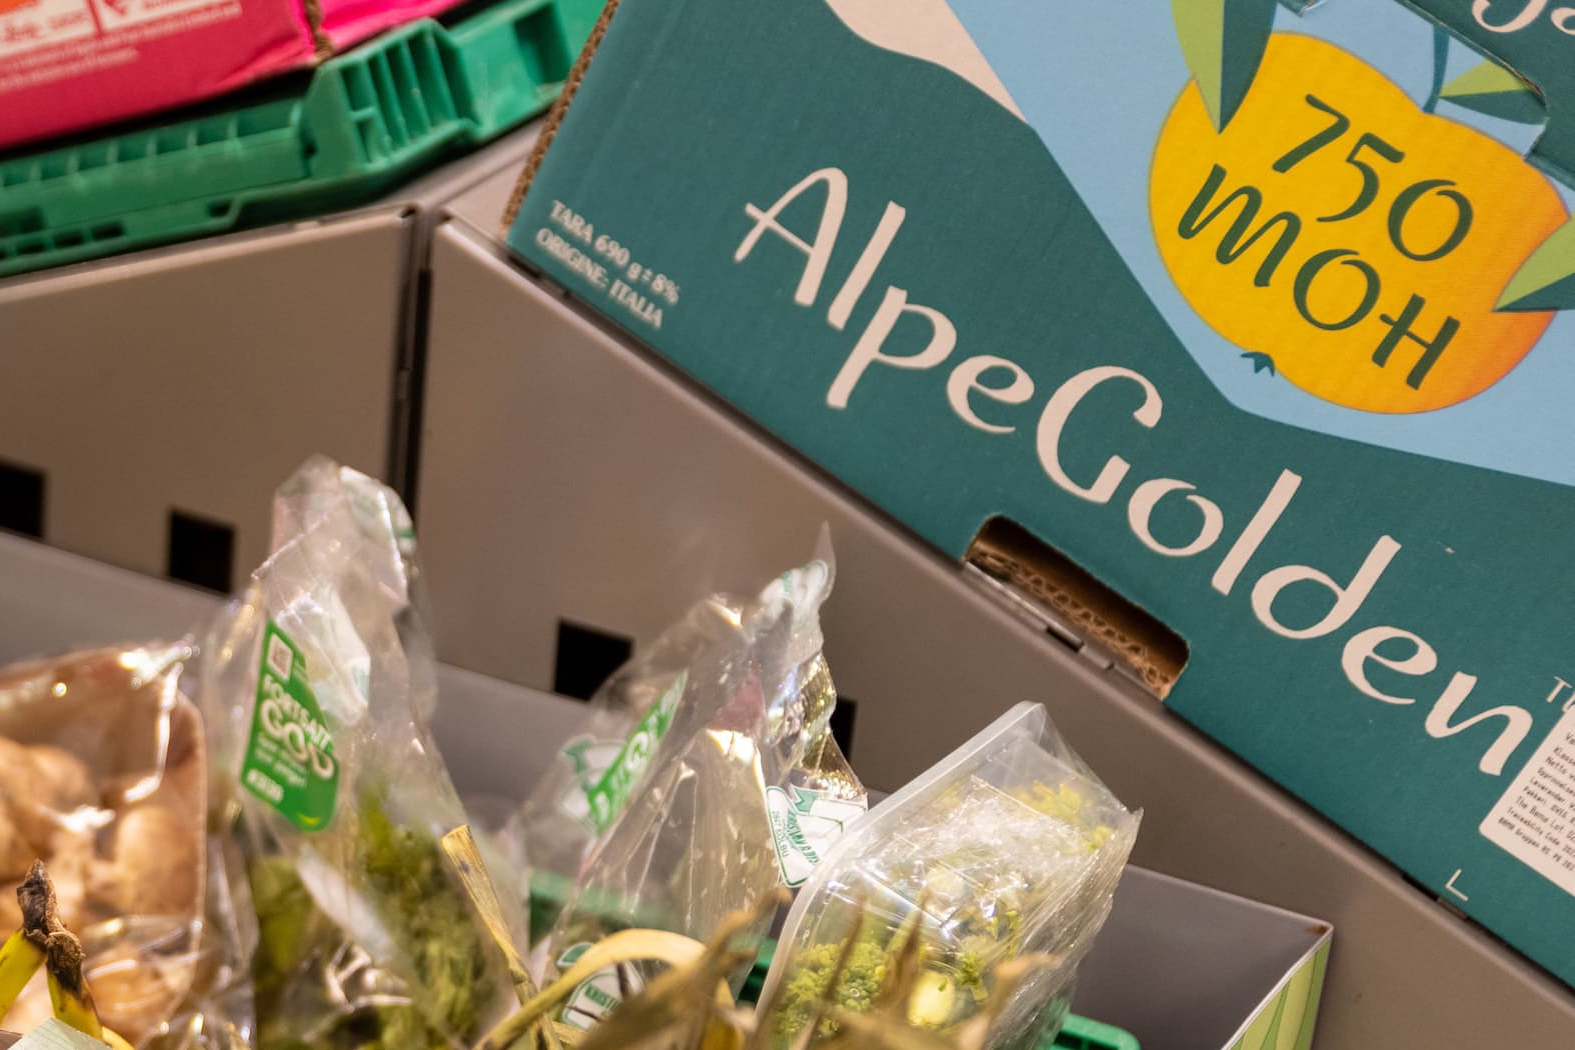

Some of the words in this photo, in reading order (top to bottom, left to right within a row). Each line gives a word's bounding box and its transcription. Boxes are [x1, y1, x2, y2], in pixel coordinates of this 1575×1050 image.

[550, 199, 593, 243] TARA
[594, 234, 631, 267] 690
[1270, 93, 1474, 263] 750
[535, 227, 610, 290] ORIGINE:
[609, 278, 664, 331] ITALIA
[1176, 163, 1462, 392] MOH
[733, 166, 1533, 777] AlpeGolden
[260, 698, 336, 780] GOD
